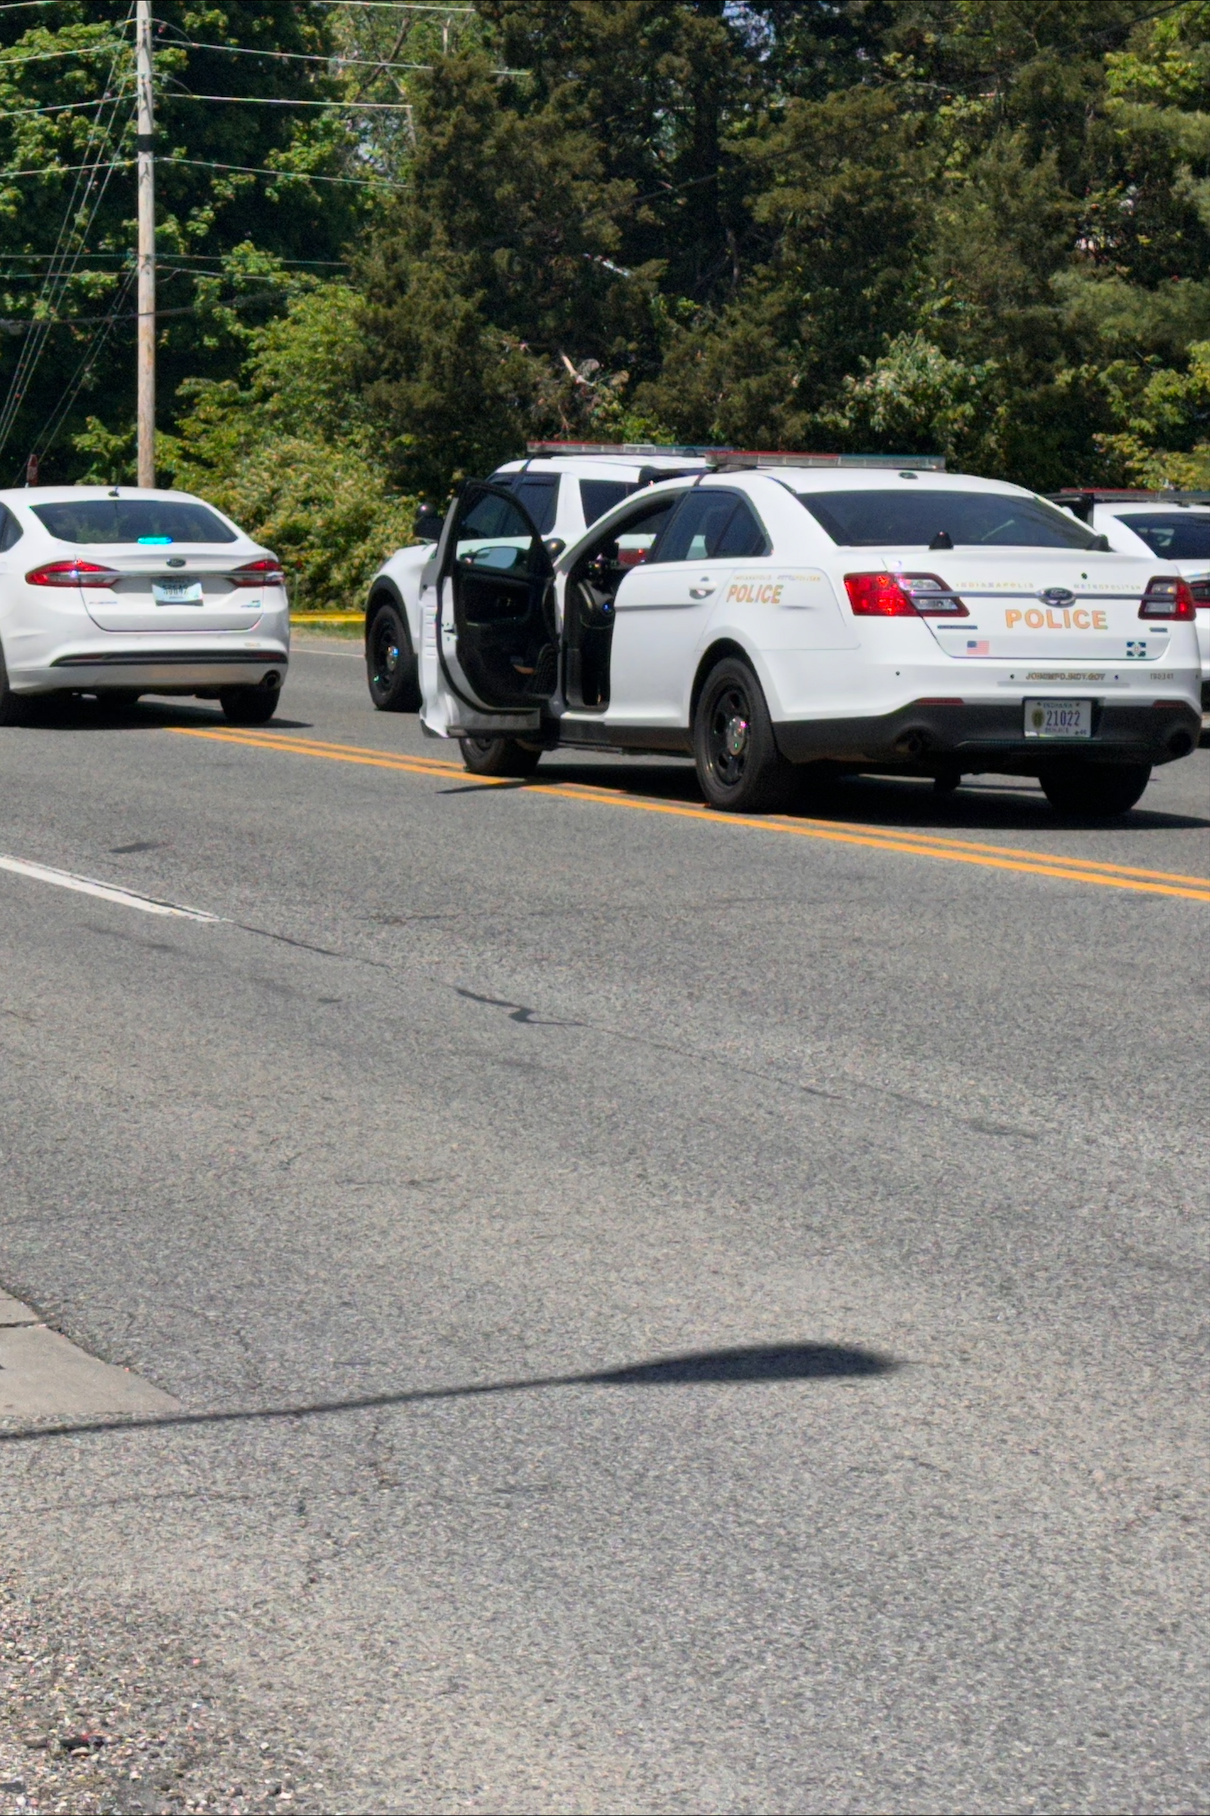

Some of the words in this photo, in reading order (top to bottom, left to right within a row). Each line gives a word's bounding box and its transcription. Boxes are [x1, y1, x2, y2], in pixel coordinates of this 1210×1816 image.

[726, 584, 784, 605] POLICE
[1004, 608, 1109, 630] POLICE
[1046, 710, 1081, 727] 21022
